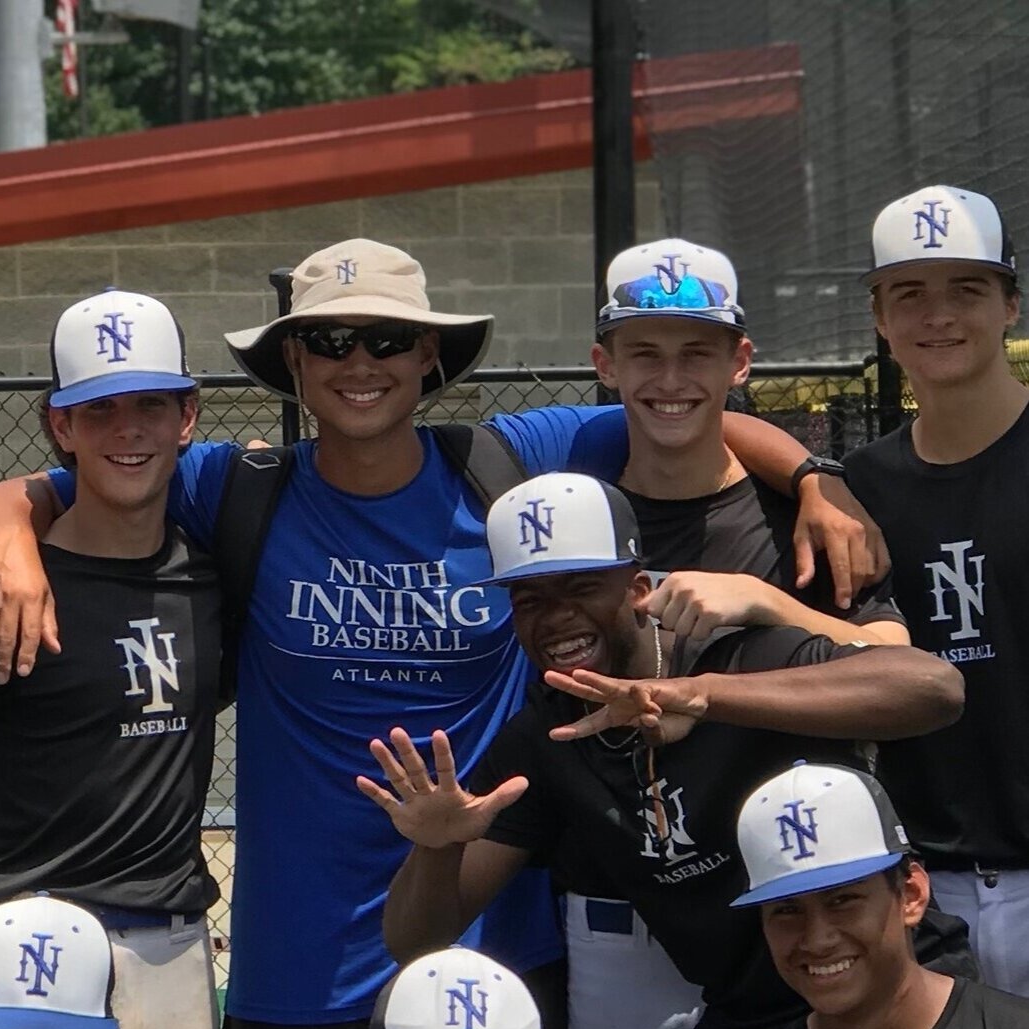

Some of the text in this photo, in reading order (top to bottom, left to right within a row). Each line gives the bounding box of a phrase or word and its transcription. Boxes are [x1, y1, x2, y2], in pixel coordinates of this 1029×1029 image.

[326, 556, 450, 589] NINTH
[285, 580, 492, 630] INNING
[309, 623, 471, 655] BASEBALL
[930, 644, 996, 664] ASEBALL
[331, 666, 444, 684] ATLANTA
